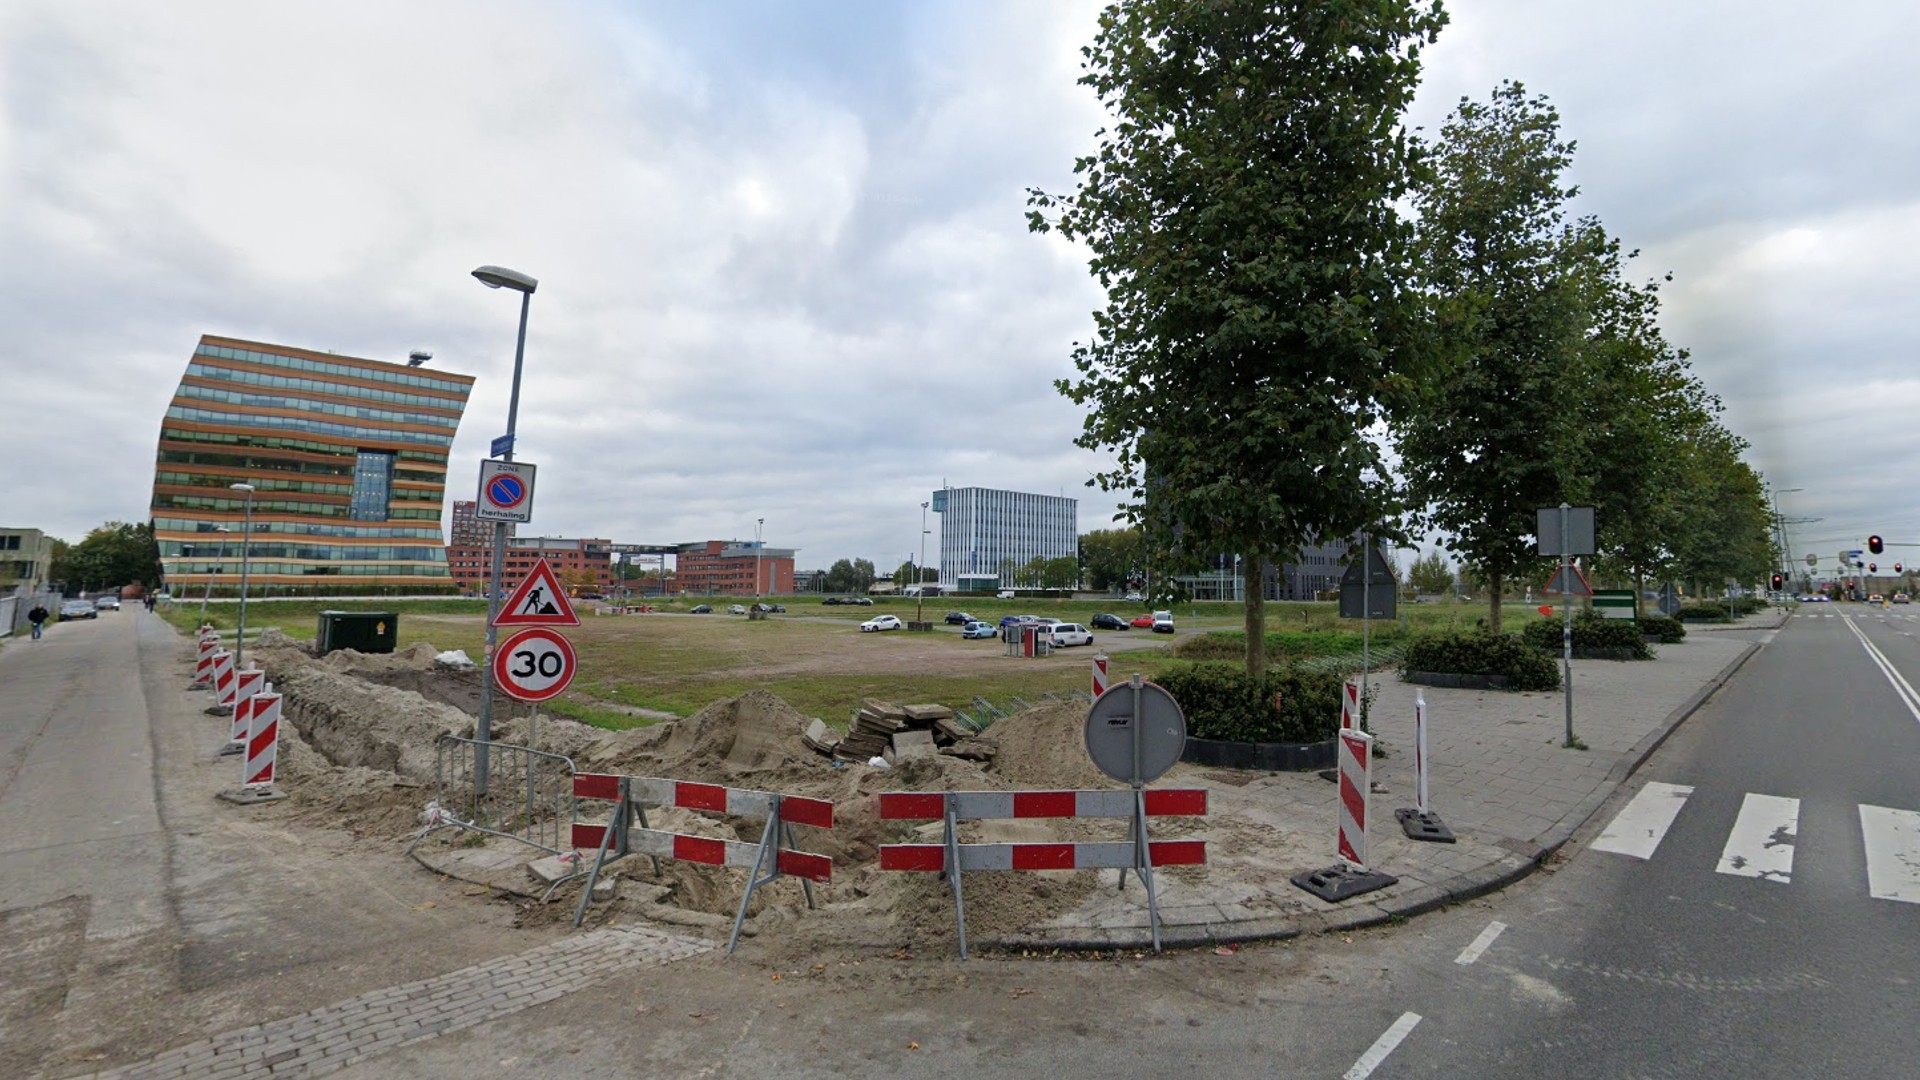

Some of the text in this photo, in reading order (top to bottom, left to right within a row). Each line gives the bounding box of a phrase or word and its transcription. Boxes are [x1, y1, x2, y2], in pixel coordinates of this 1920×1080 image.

[497, 464, 520, 473] ZONE
[481, 509, 526, 520] herhaling
[511, 650, 563, 678] 30
